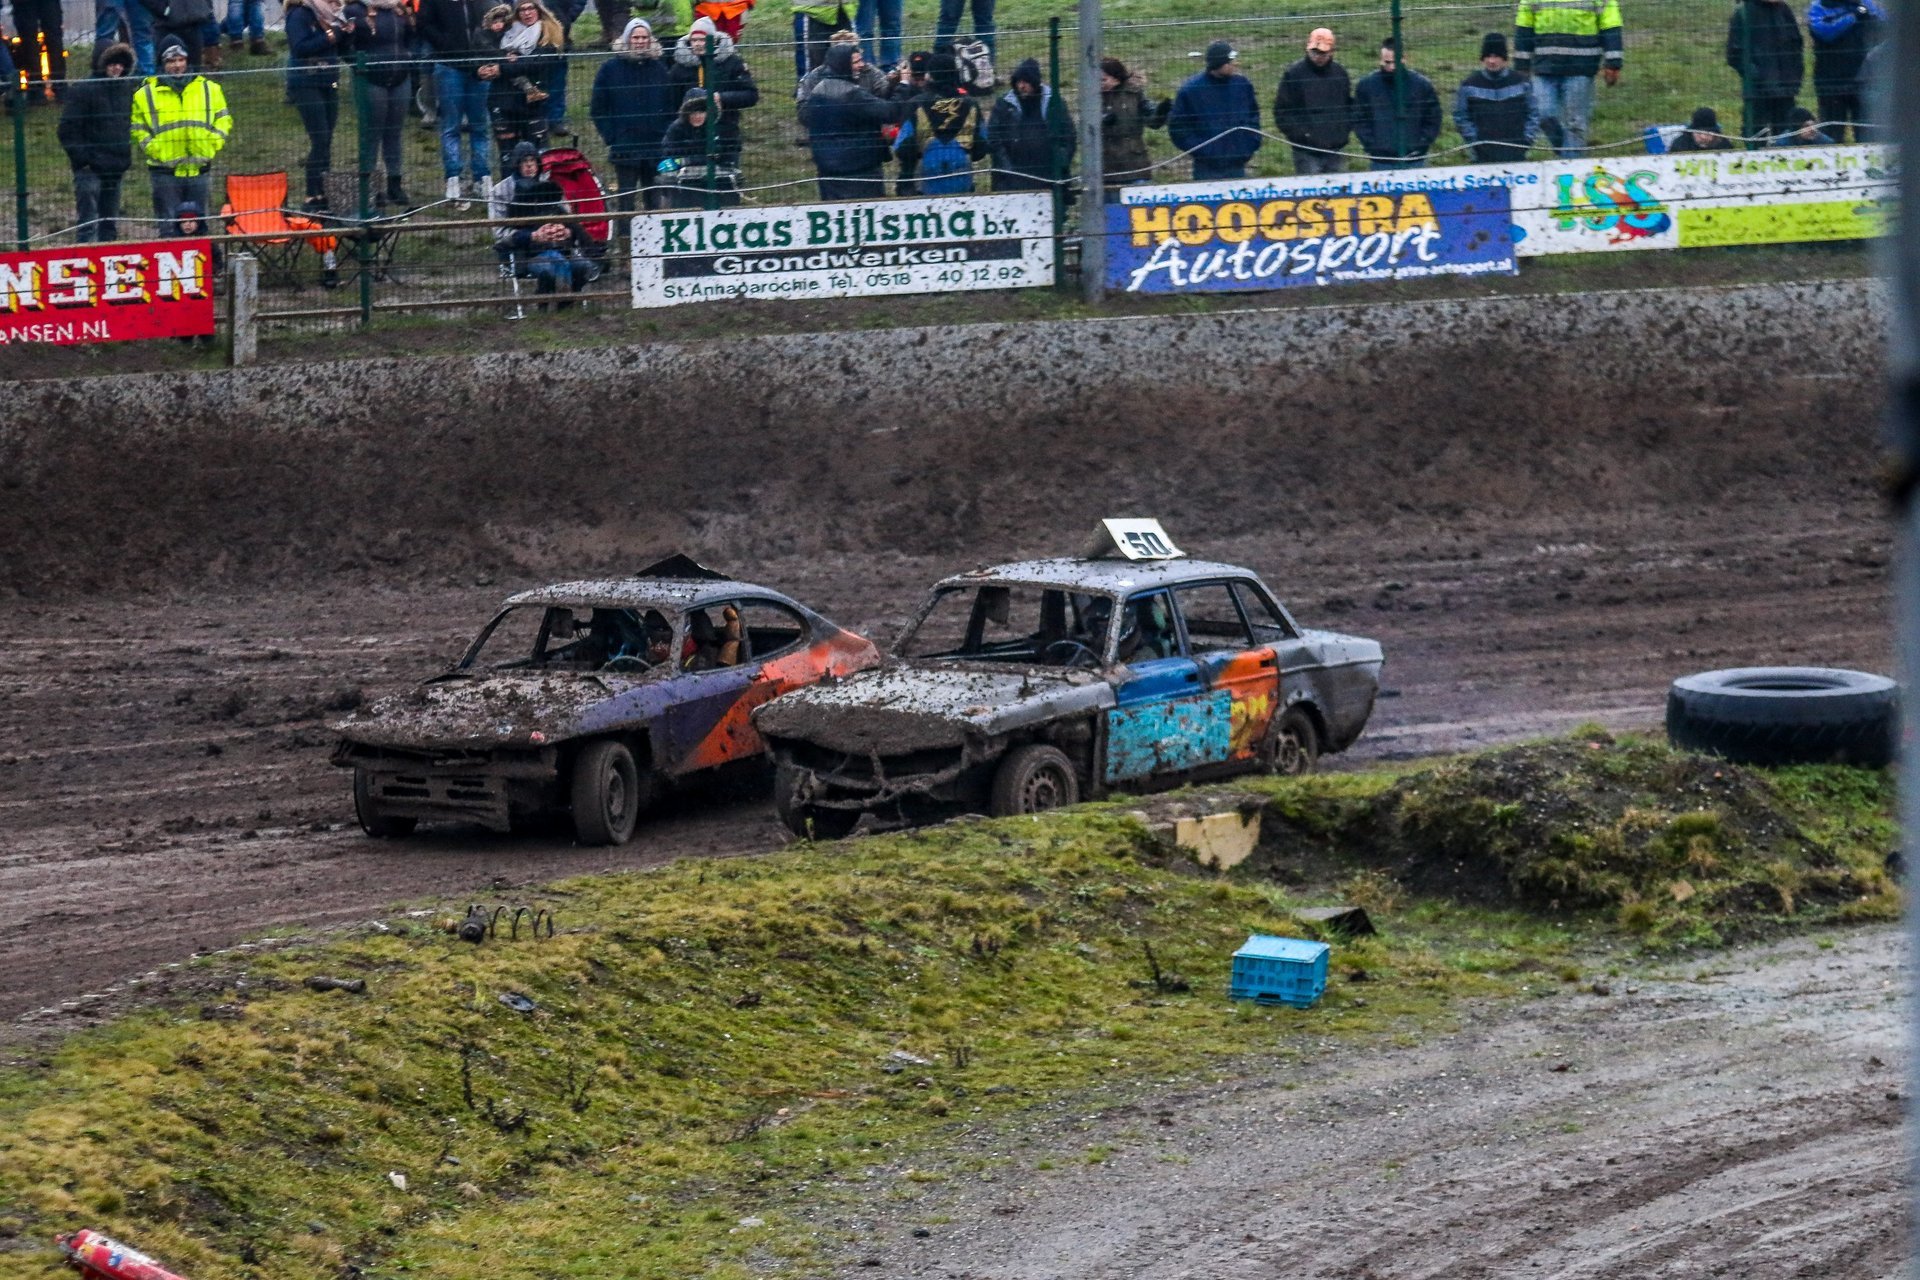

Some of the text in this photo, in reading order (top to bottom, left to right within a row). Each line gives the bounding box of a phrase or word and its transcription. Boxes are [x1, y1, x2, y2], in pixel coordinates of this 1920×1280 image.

[1464, 172, 1538, 189] Service
[661, 208, 1020, 253] Klaas Bijlsma b.v.
[1129, 193, 1440, 247] HOOGSTRA
[713, 247, 968, 275] Grondwerken
[1126, 222, 1441, 292] Autosport
[0, 249, 206, 312] NSEN
[829, 274, 857, 288] Tel.
[867, 273, 911, 287] 0518
[938, 269, 963, 283] 40
[972, 268, 989, 281] 12
[999, 266, 1022, 280] 92
[1124, 532, 1172, 556] 50
